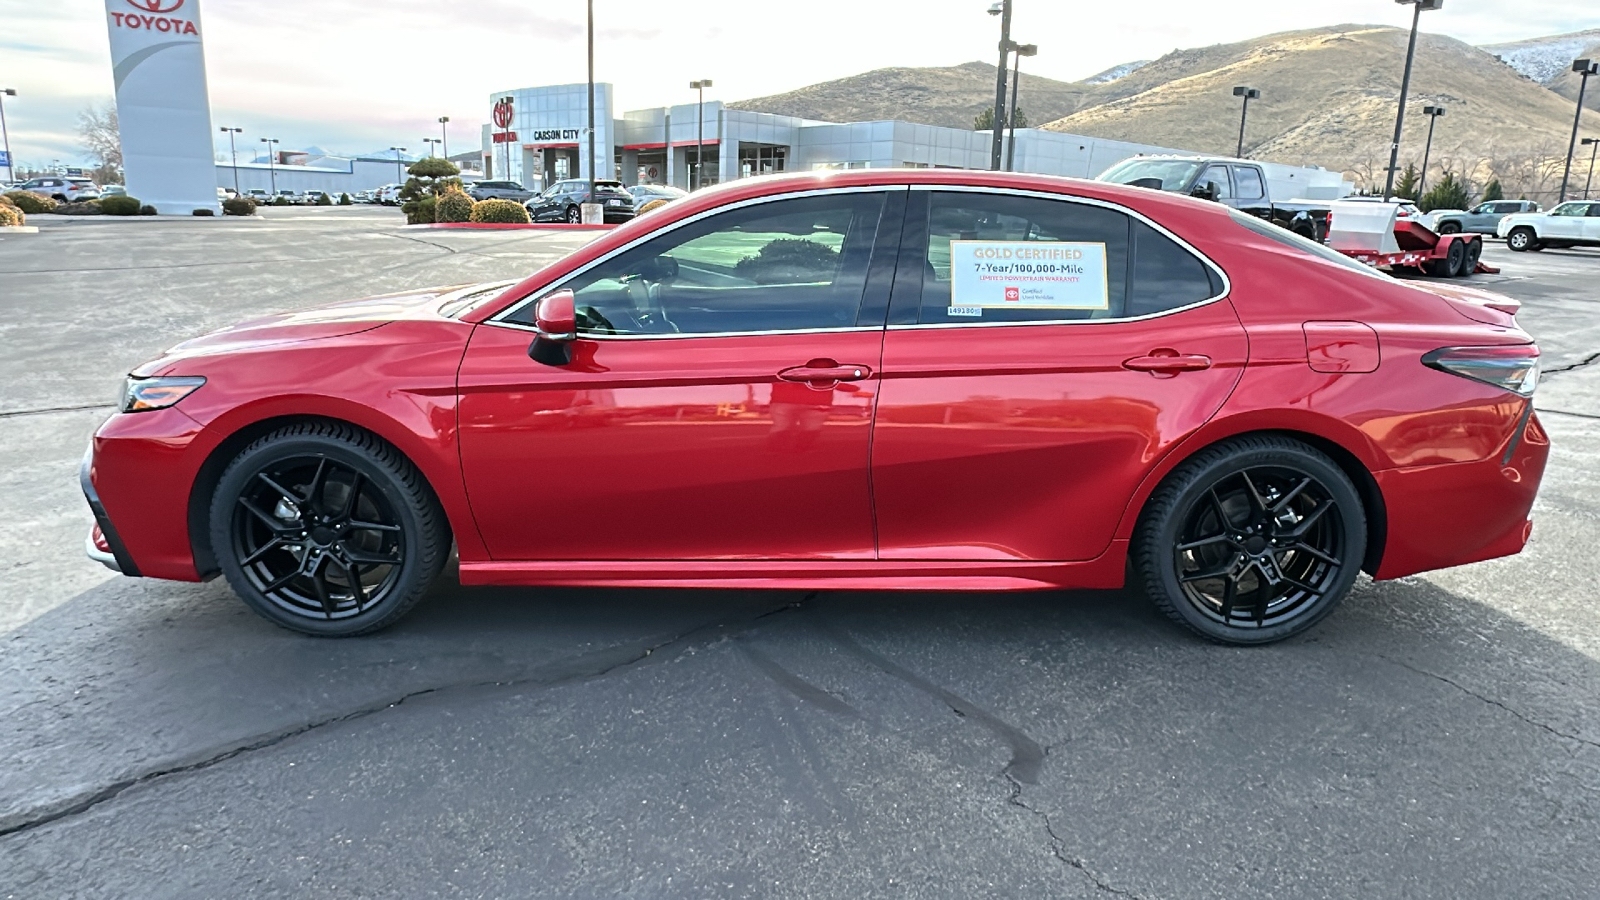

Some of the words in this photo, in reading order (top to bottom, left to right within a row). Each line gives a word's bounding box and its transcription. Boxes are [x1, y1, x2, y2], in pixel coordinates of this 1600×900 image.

[110, 12, 198, 35] TOYOTA
[534, 130, 561, 141] CARSON
[562, 129, 580, 140] CITY
[974, 247, 1012, 259] GOLD
[1015, 247, 1082, 260] CERTIFIED
[974, 263, 1084, 275] 7-Year/100,000-Mile
